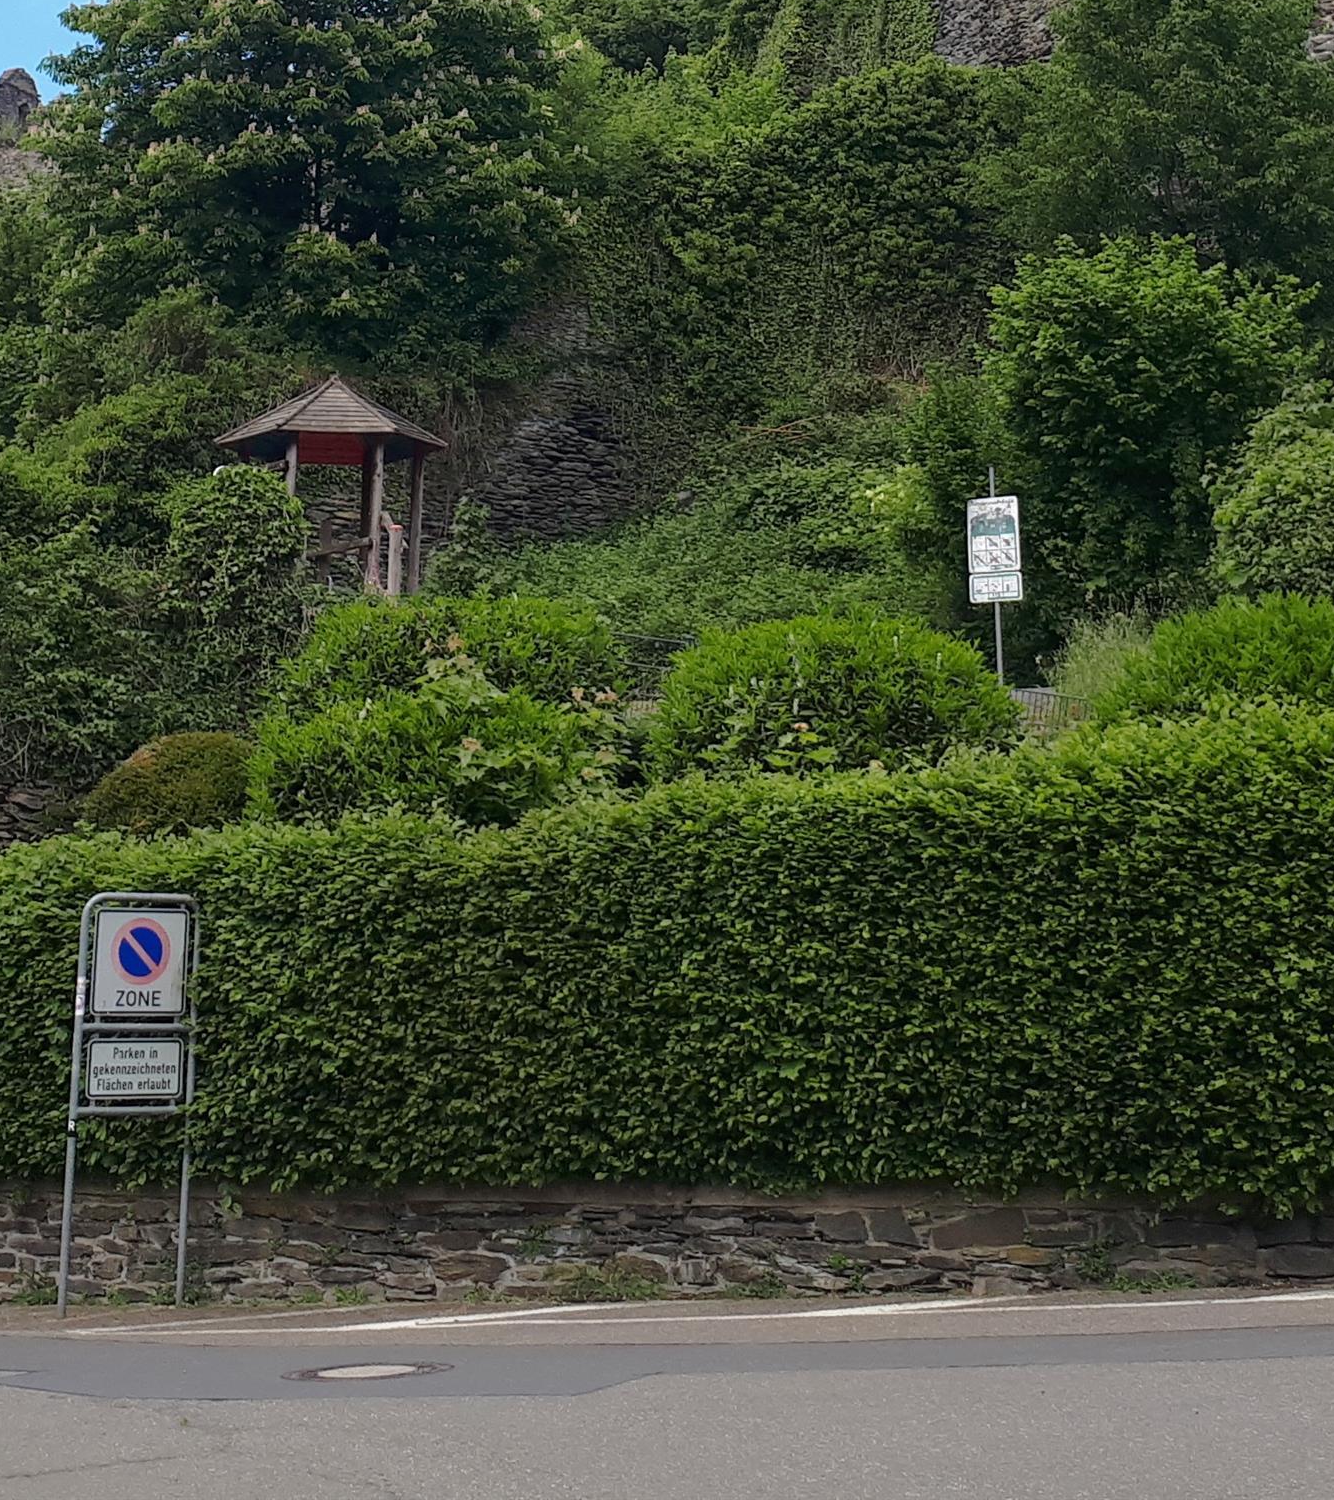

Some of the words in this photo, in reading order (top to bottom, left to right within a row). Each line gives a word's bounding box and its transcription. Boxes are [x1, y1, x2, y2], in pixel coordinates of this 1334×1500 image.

[115, 990, 162, 1007] ZONE
[113, 1047, 145, 1059] Parken
[149, 1047, 158, 1058] in
[93, 1062, 176, 1078] gekennzeichneten
[97, 1078, 133, 1090] Flächen
[138, 1078, 170, 1090] erlaubt
